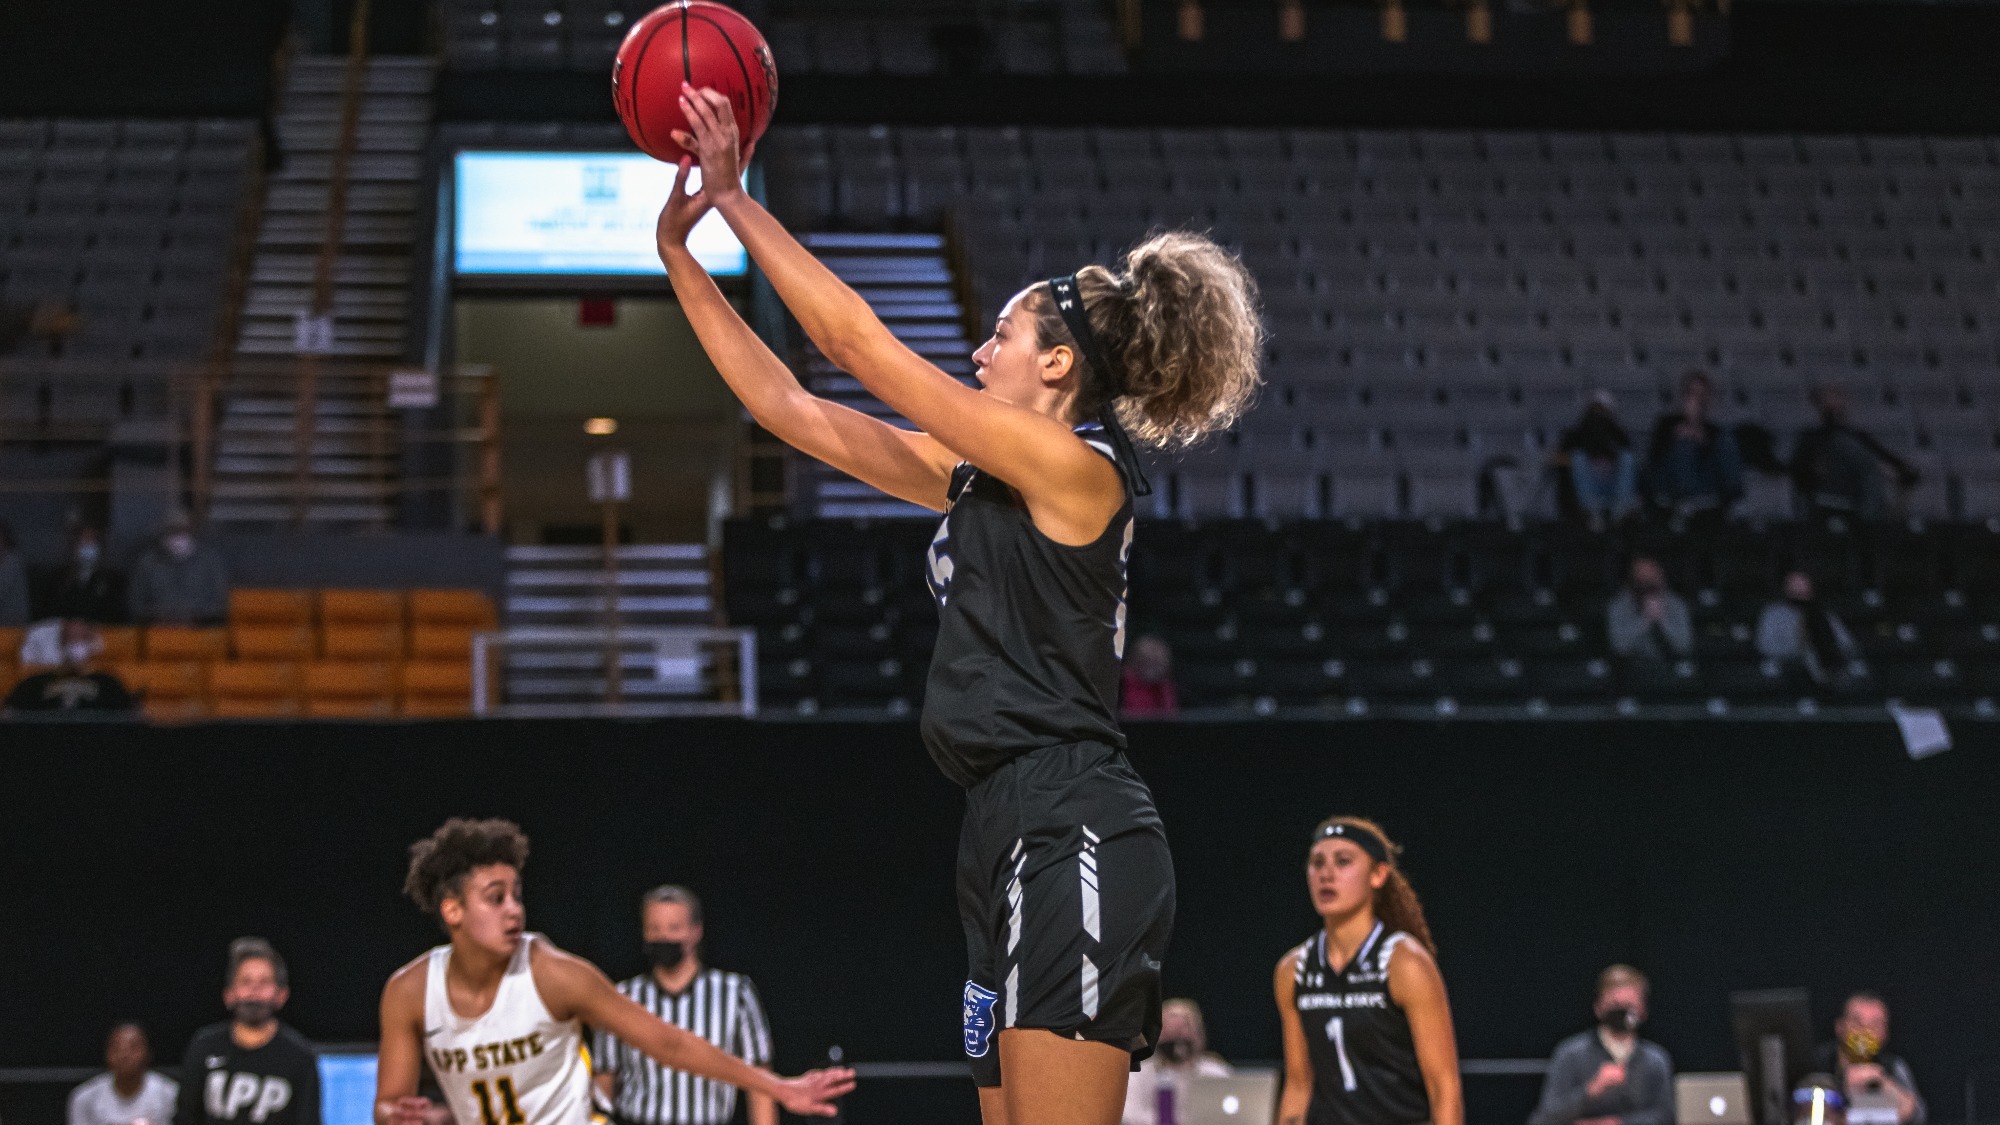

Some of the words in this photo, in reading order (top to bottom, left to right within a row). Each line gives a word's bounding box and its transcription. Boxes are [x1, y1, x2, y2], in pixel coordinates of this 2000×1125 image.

[472, 1030, 544, 1071] STATE
[1325, 1016, 1357, 1091] 1
[470, 1075, 527, 1125] 11
